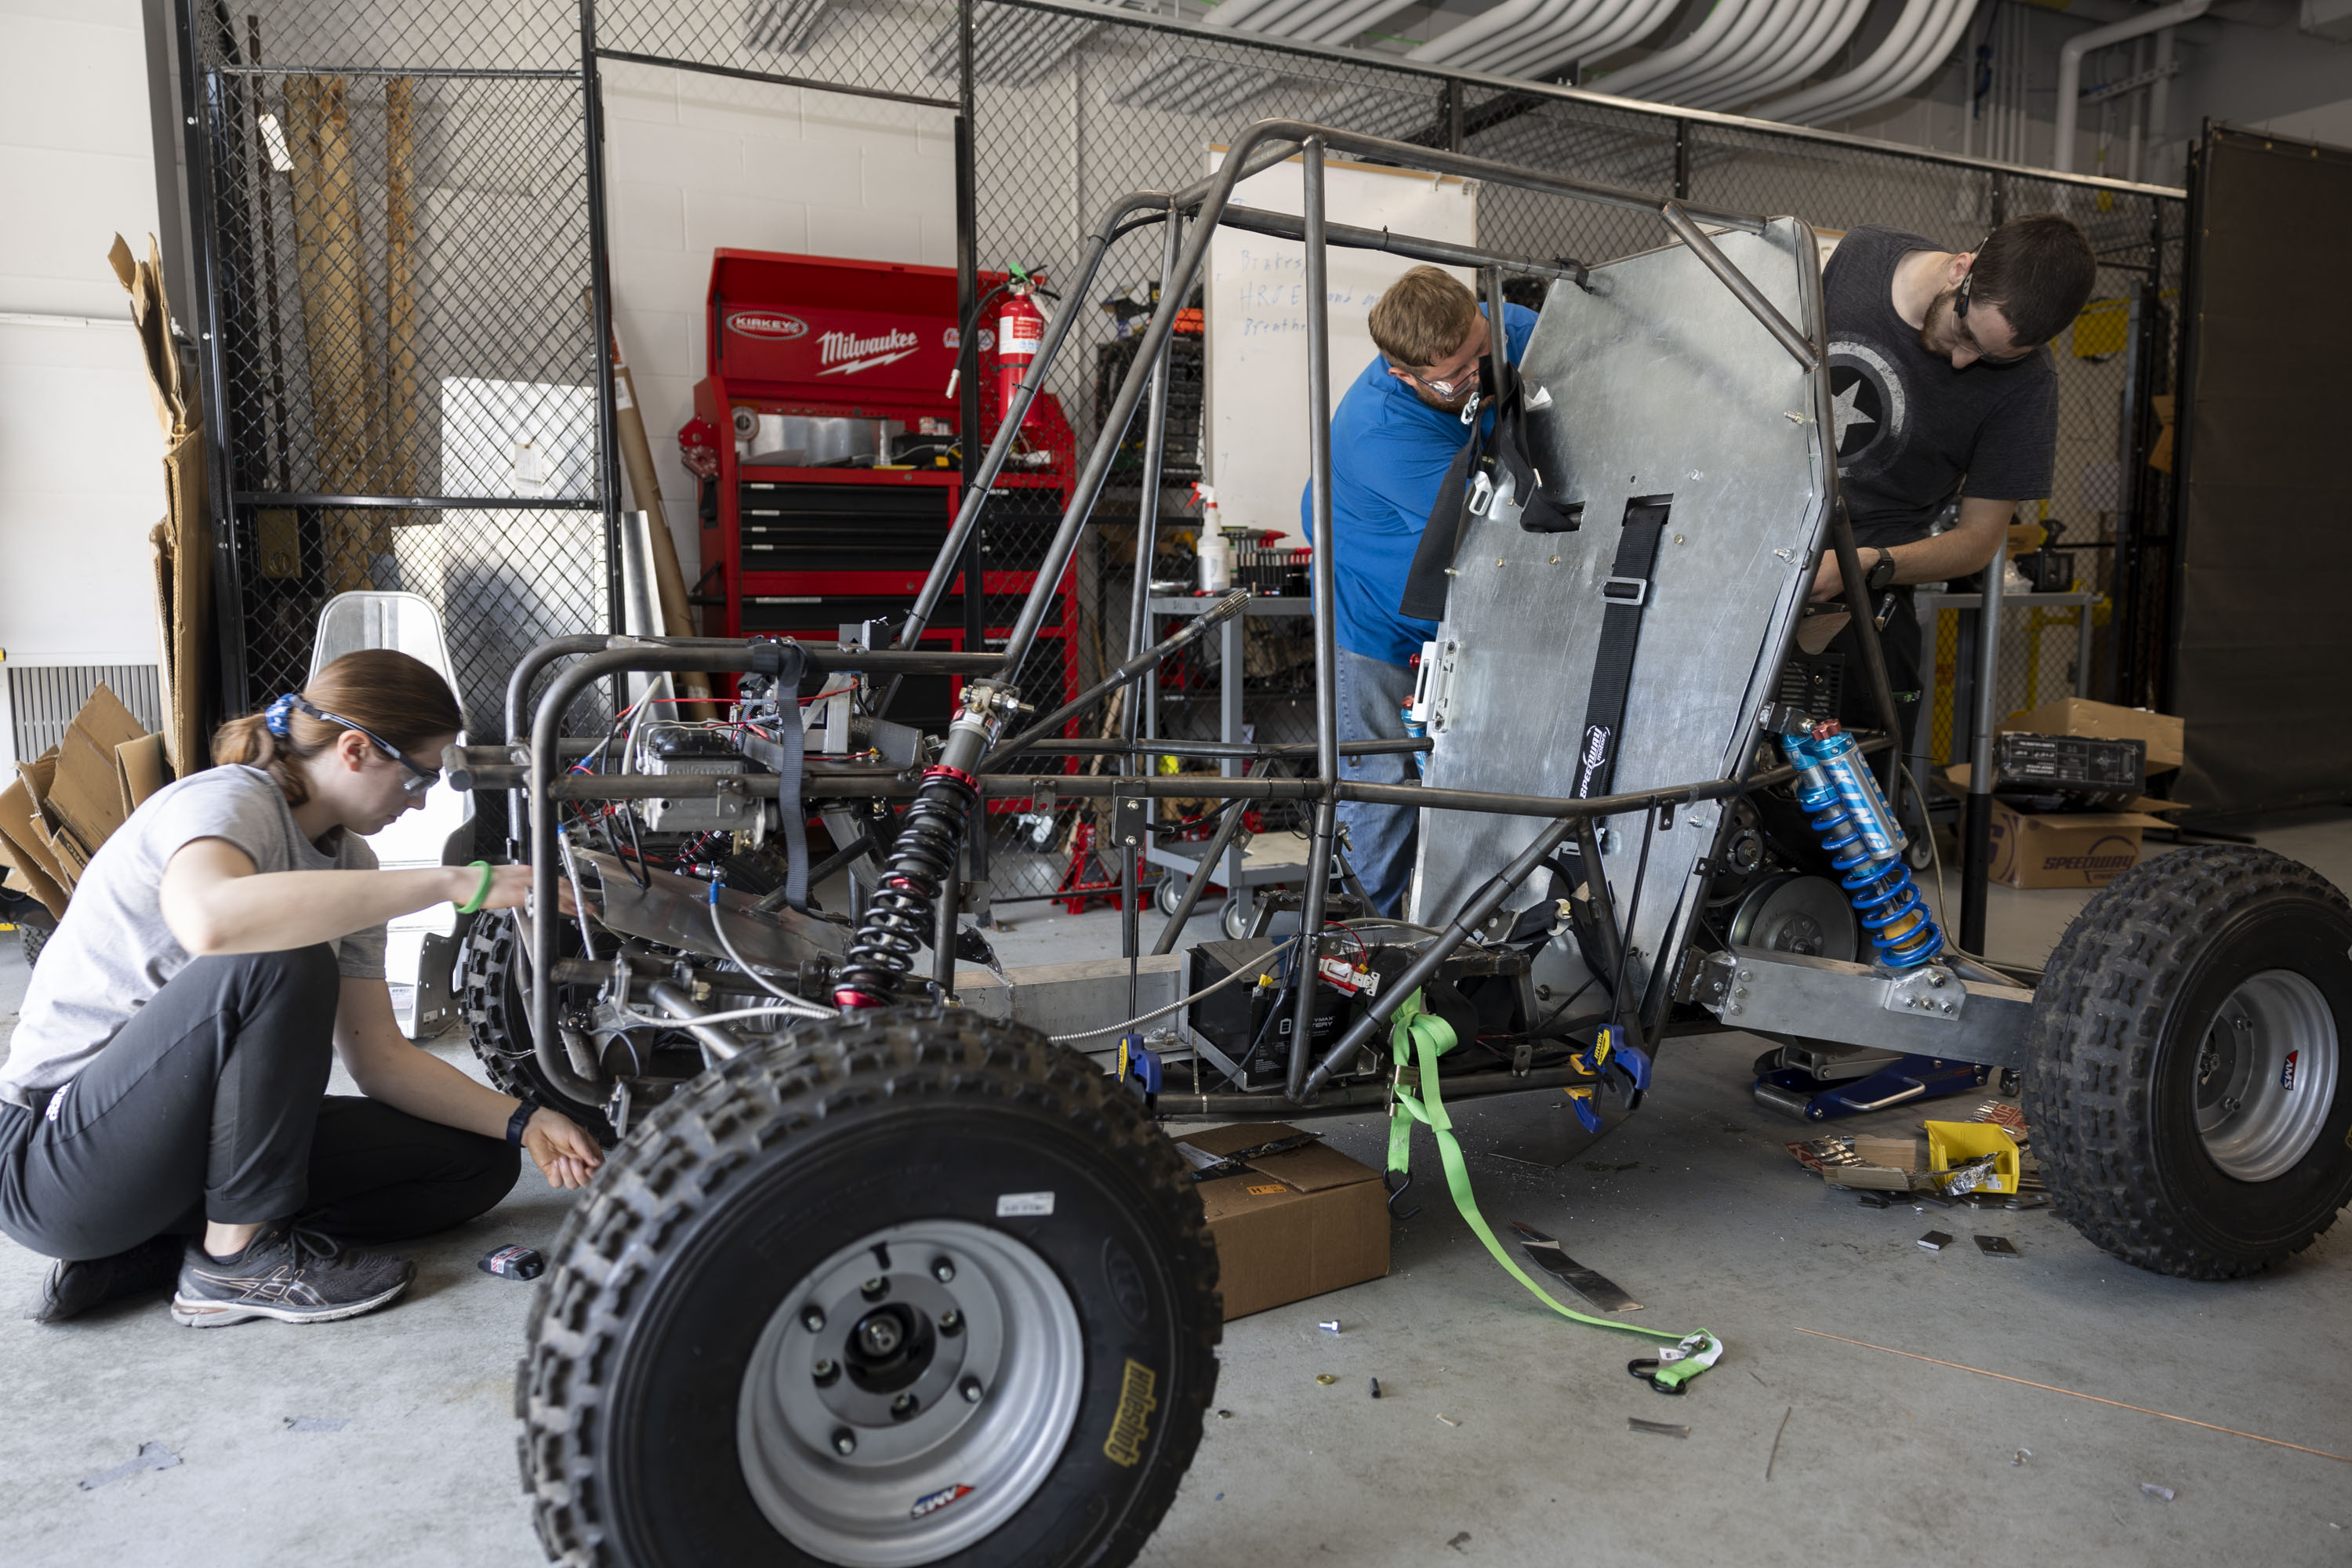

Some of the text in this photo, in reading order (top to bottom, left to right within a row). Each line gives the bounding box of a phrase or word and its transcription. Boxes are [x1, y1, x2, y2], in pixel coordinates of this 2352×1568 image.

[735, 318, 792, 329] KIRKEY
[815, 328, 918, 365] Milwaukee
[1829, 768, 1888, 849] KING
[2042, 855, 2137, 870] SPEEDWAY
[1594, 1032, 1603, 1059] IRWIN
[2284, 1058, 2294, 1089] AMS
